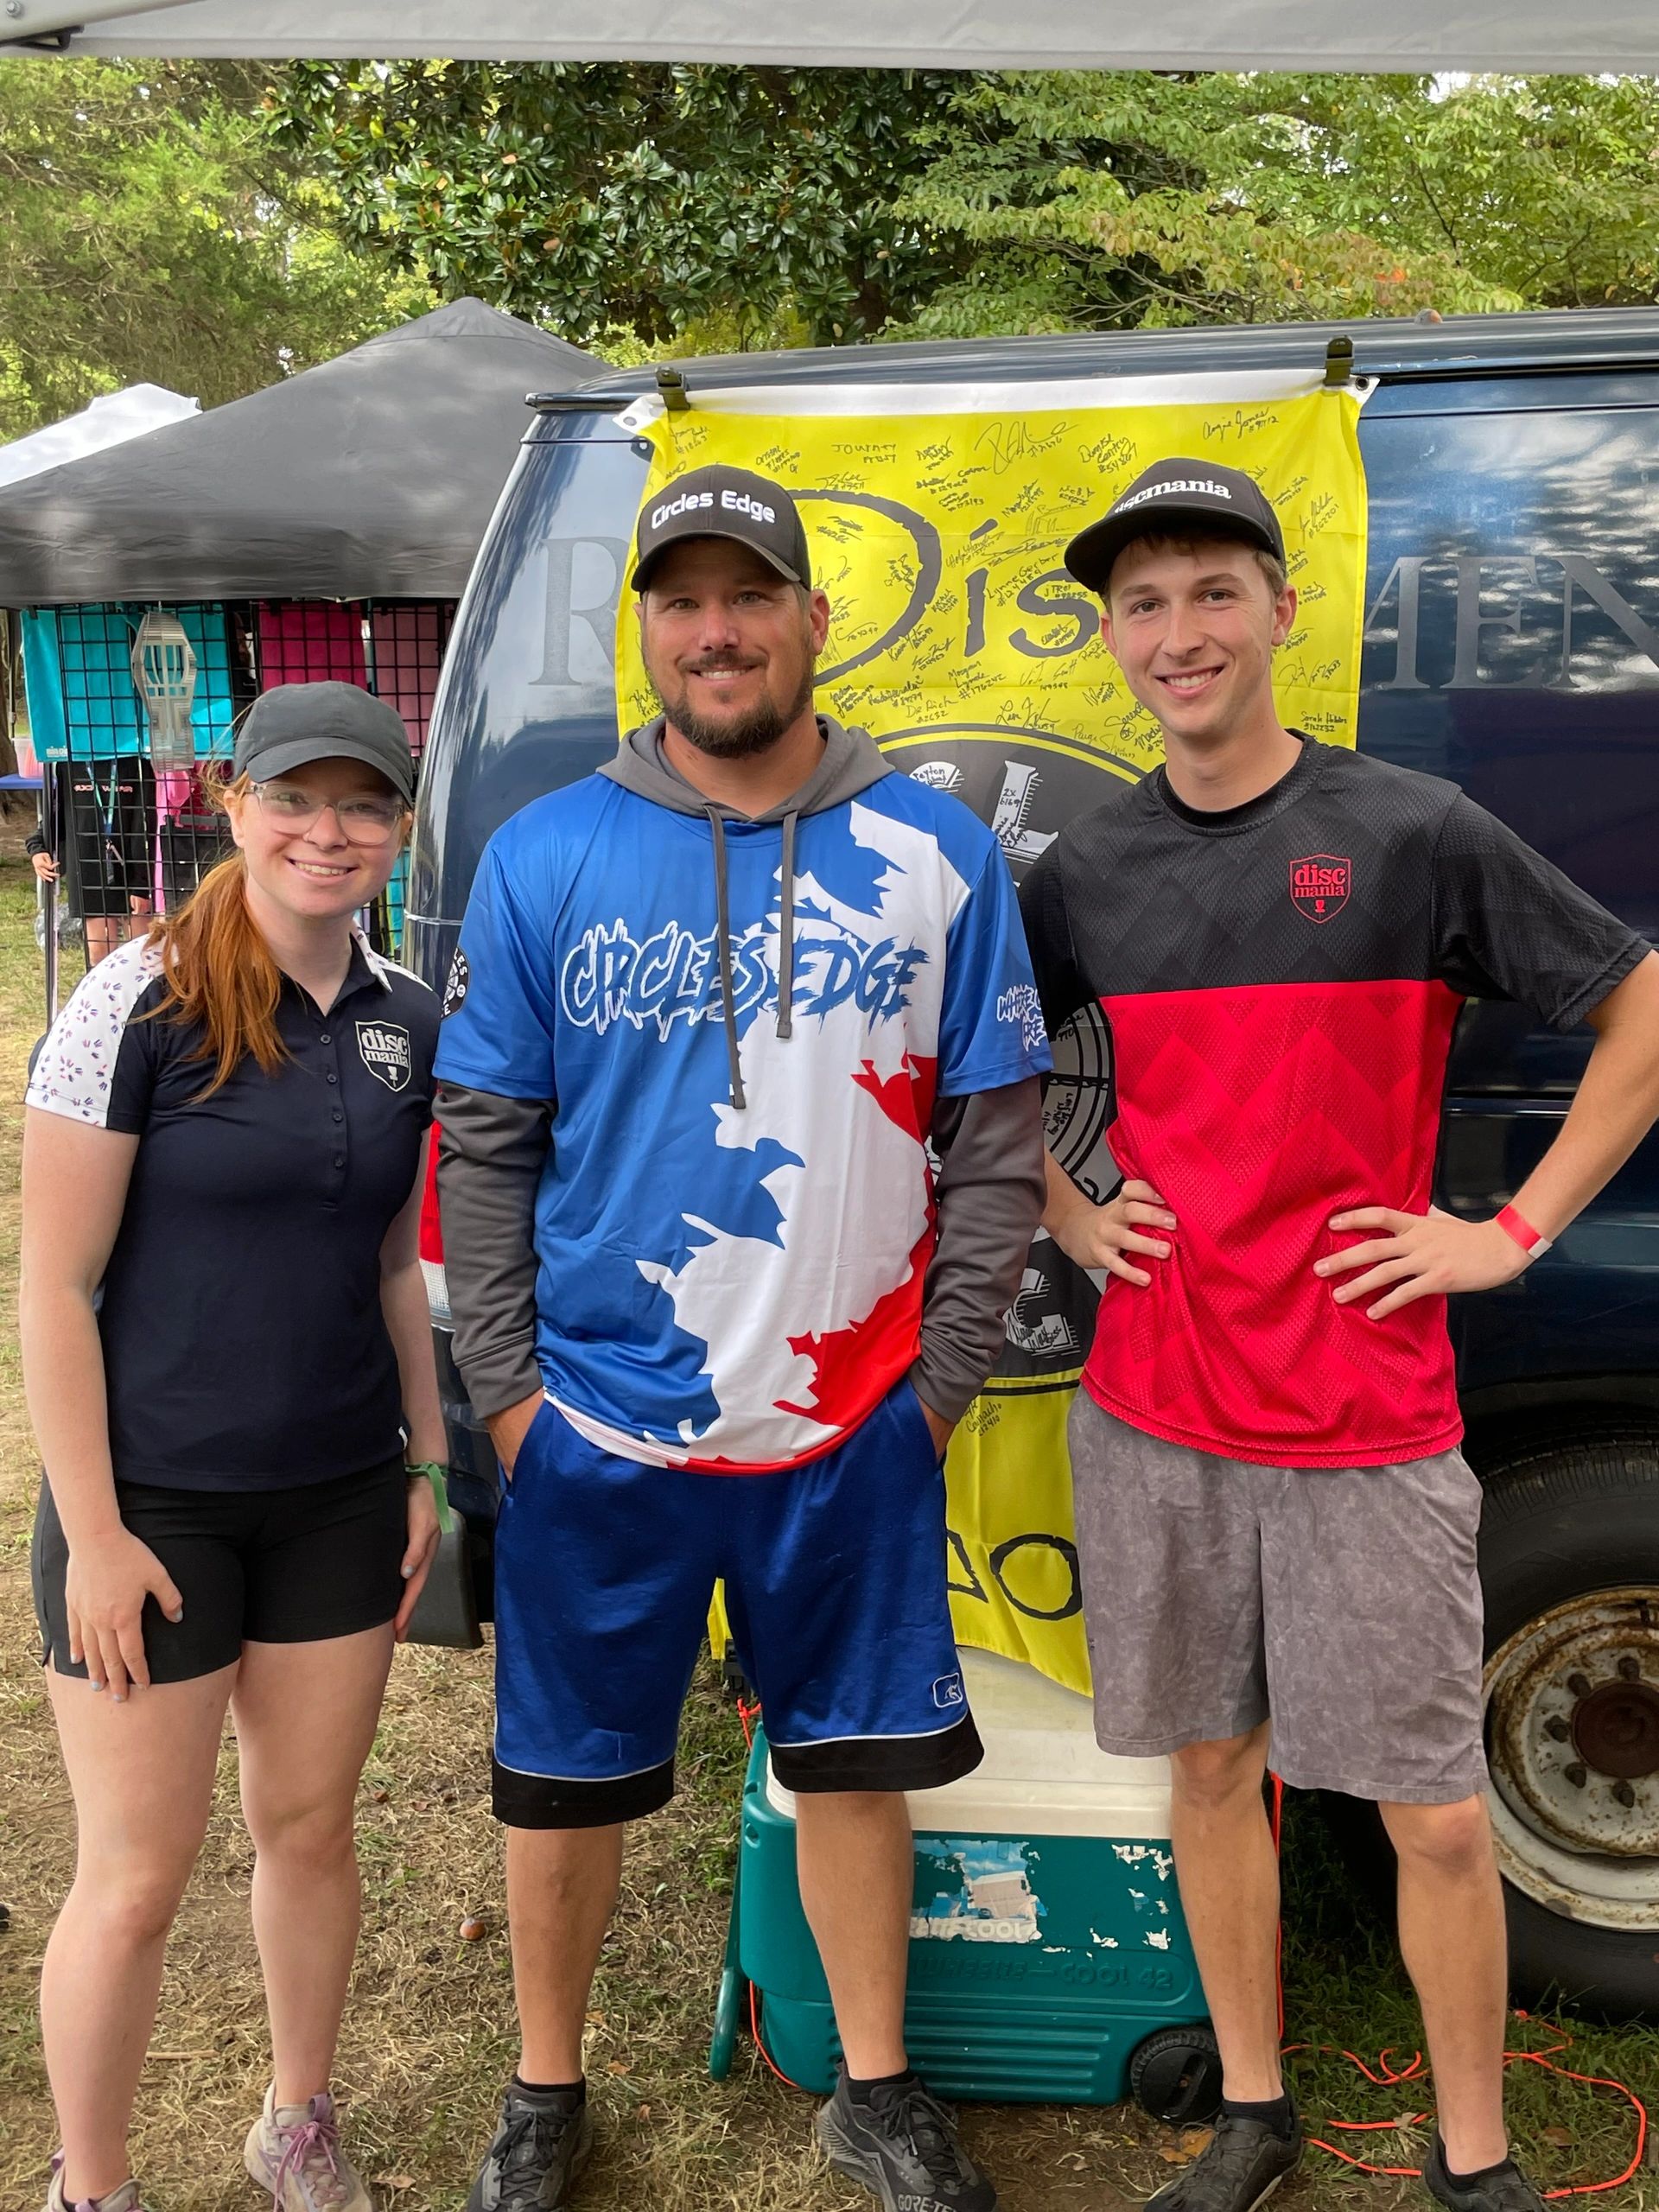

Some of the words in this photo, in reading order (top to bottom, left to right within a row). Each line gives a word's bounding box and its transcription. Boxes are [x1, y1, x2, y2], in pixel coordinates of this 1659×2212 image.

[1114, 479, 1232, 514] iscmania
[651, 492, 714, 530] Circles
[721, 490, 776, 524] Edge
[1294, 863, 1346, 887] disc
[1294, 883, 1346, 898] mania
[361, 1027, 408, 1056] disc
[363, 1049, 410, 1069] mania
